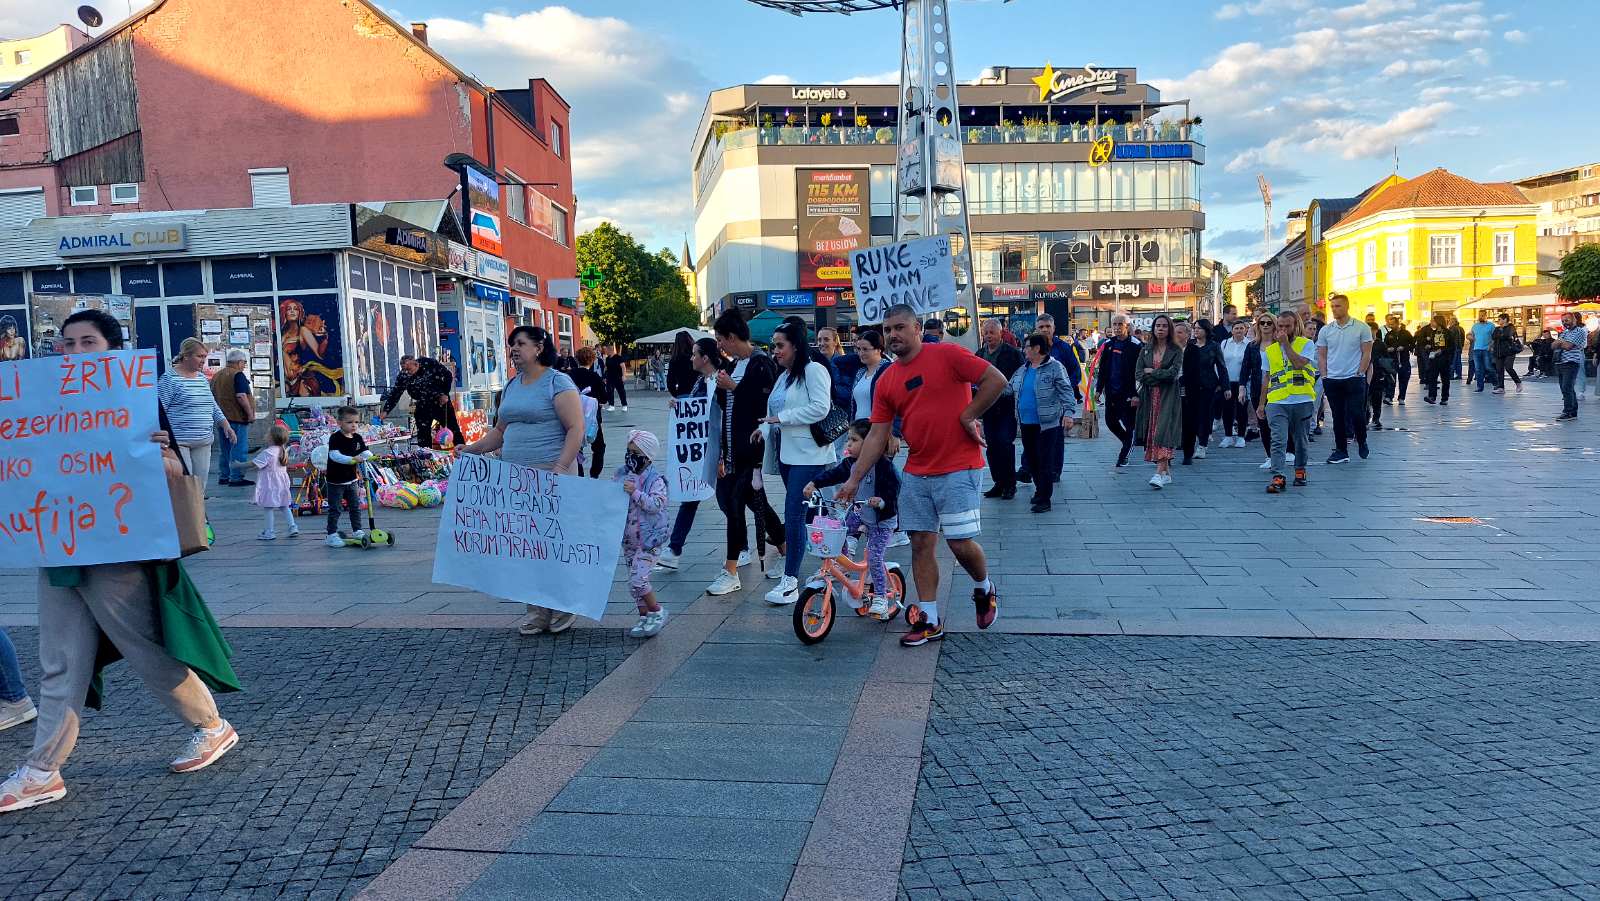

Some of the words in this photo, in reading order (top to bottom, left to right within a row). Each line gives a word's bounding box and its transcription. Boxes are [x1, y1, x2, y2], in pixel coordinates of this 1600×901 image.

[1050, 63, 1119, 93] CineStar
[808, 183, 830, 197] 115
[832, 183, 859, 197] KM
[59, 233, 131, 250] ADMIRAL
[133, 230, 179, 245] CLUB
[816, 240, 830, 251] BEZ
[830, 238, 858, 250] USLOVA
[855, 243, 912, 278] RUKE
[860, 279, 877, 294] SU
[887, 268, 921, 289] VAM
[1099, 281, 1140, 297] sinsay
[770, 295, 785, 304] SR
[60, 355, 157, 395] ŽRTVE
[0, 406, 129, 440] ezerinama
[60, 450, 116, 475] OSIM
[509, 464, 540, 494] BORI
[545, 473, 559, 497] SE
[456, 483, 466, 503] U
[471, 484, 506, 509] OVOM
[510, 491, 561, 515] GRADU
[455, 505, 492, 530] NEMA
[495, 510, 540, 536] MJESTA
[544, 517, 564, 540] ZA
[552, 543, 600, 566] VLAST!
